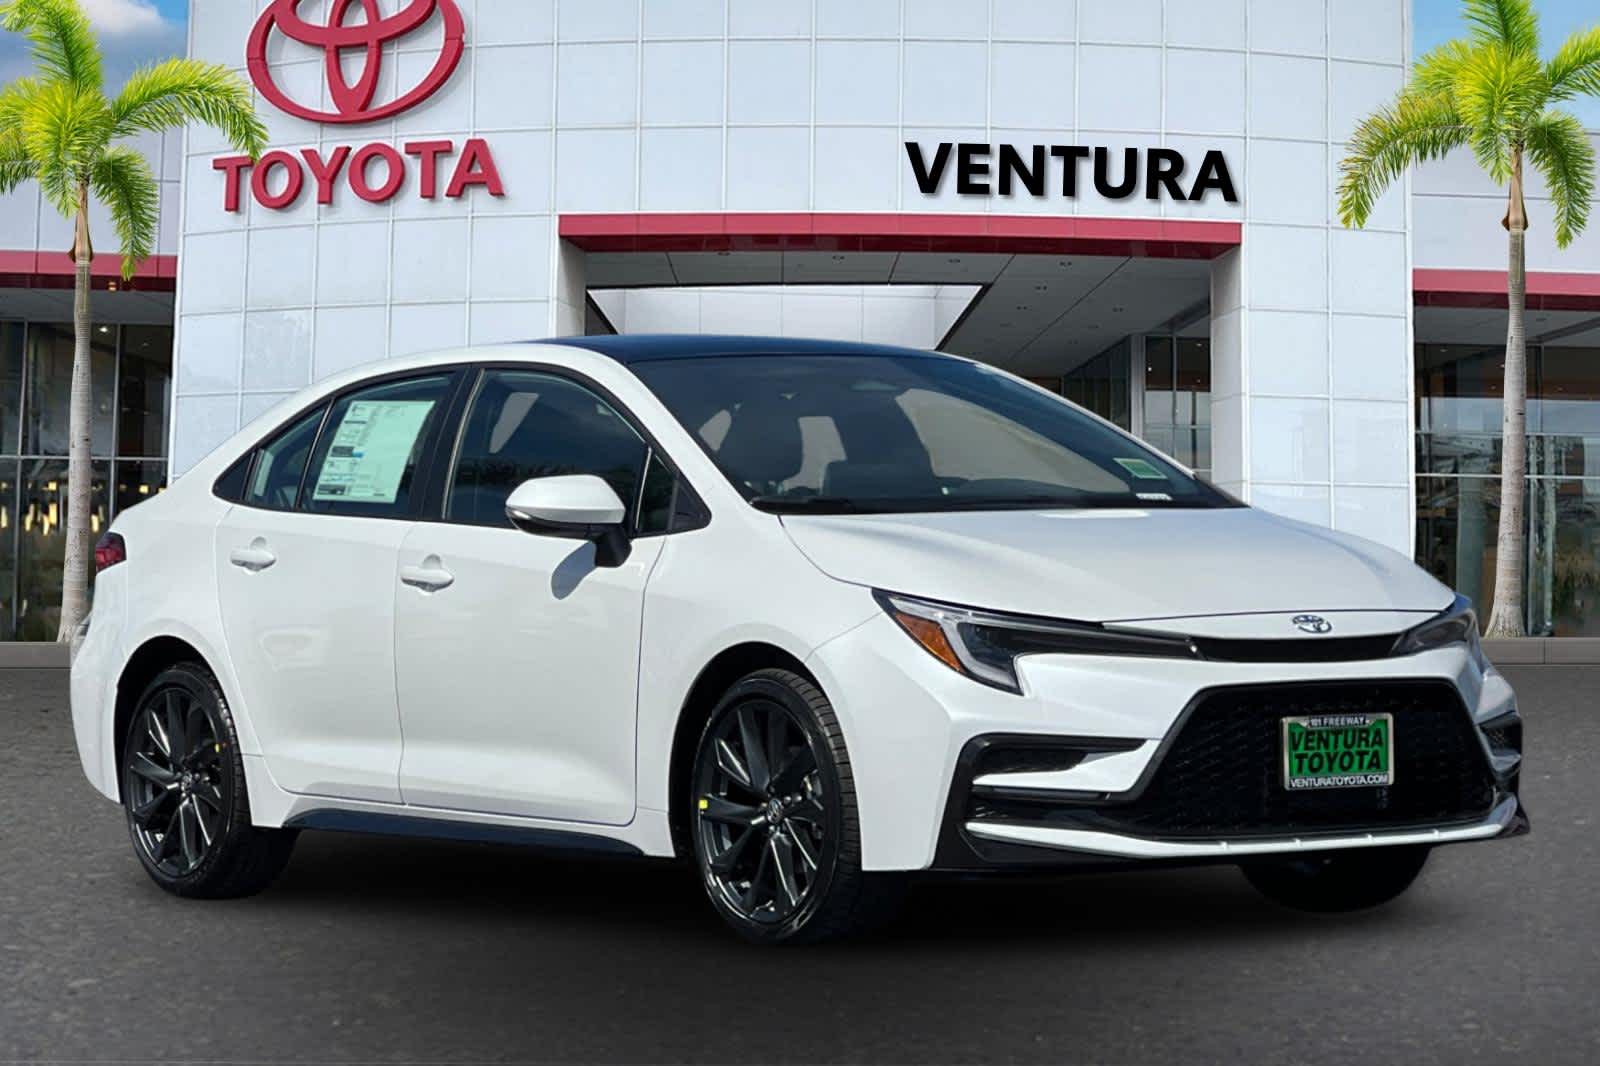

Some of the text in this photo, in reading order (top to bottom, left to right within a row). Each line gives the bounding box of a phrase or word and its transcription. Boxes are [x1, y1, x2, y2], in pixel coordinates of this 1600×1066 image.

[212, 138, 505, 212] TOYOTA
[904, 141, 1238, 202] VENTURA
[1323, 716, 1365, 727] FREEWAY
[1290, 728, 1384, 751] VENTURA
[1294, 750, 1381, 774] TOYOTA
[1290, 774, 1389, 788] VENTURATOYOTA.COM
